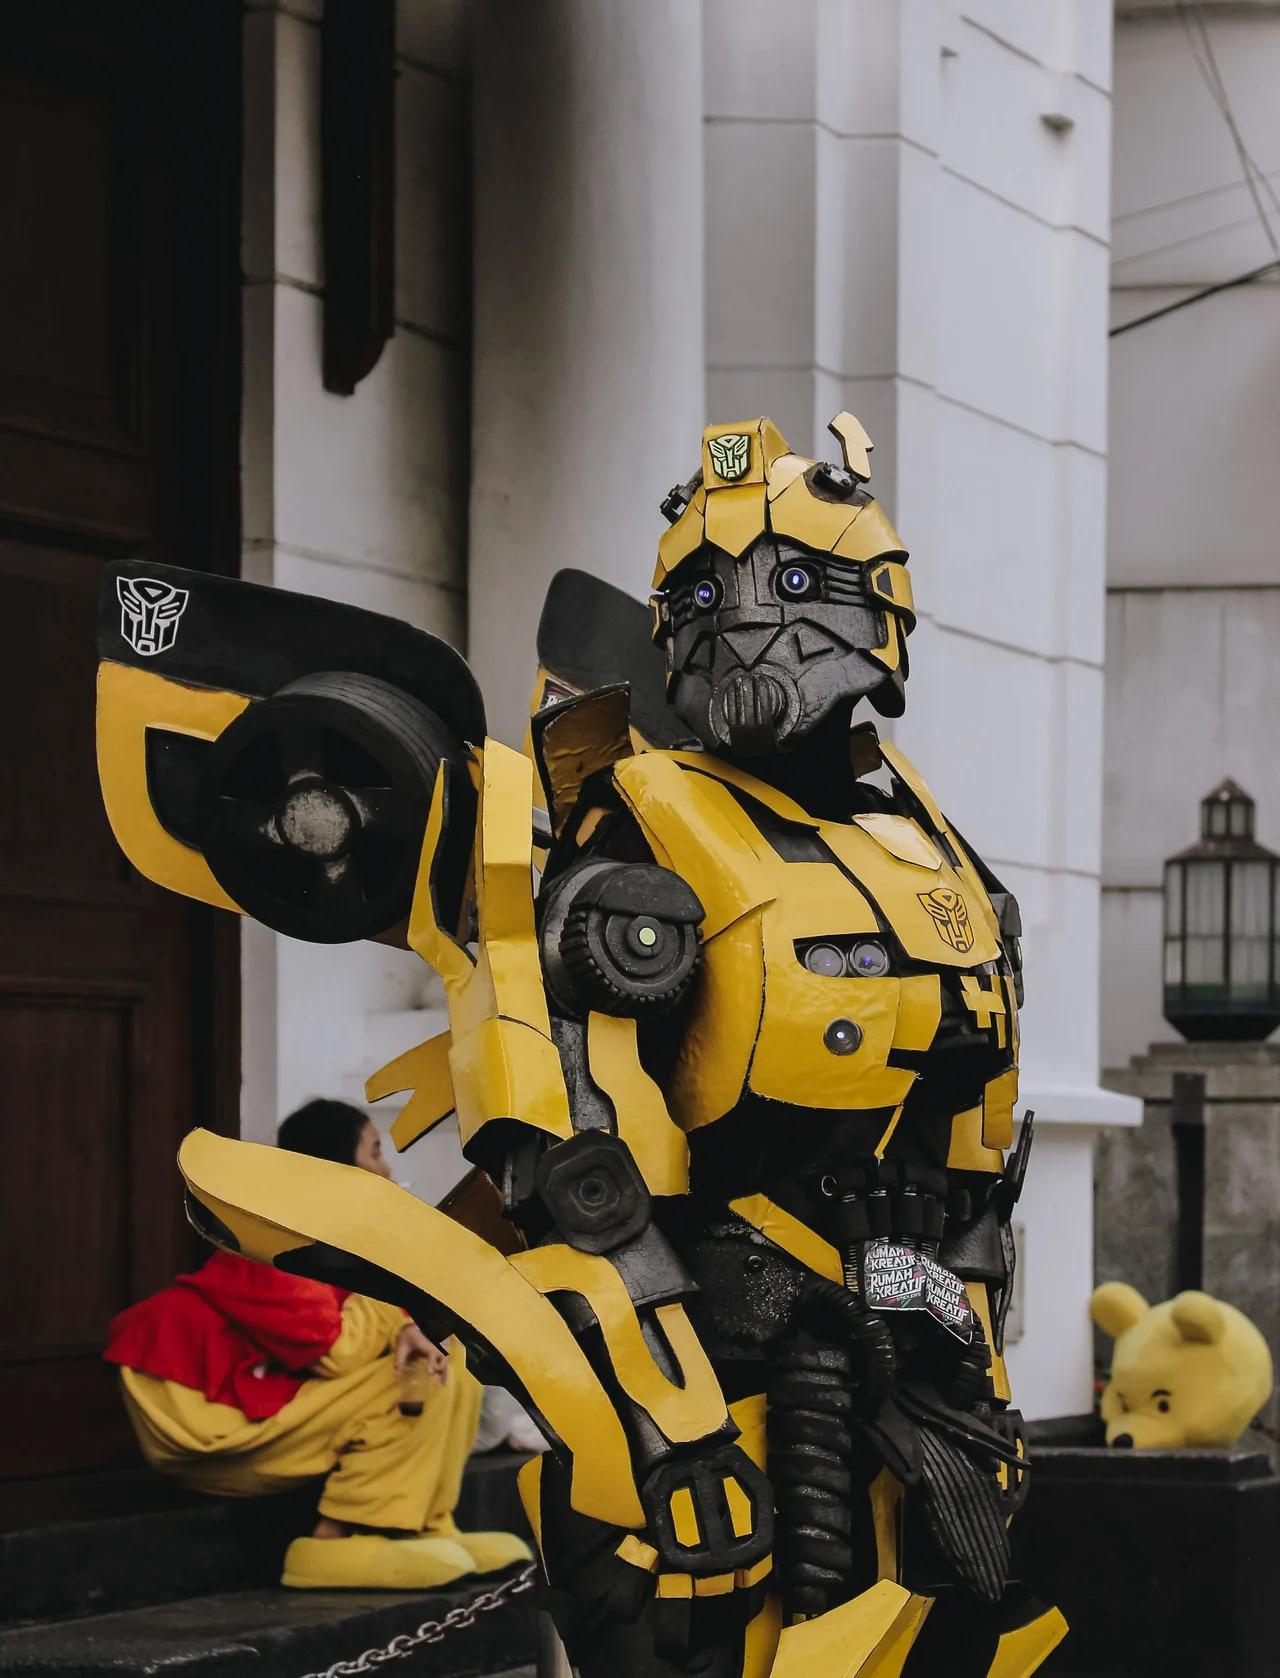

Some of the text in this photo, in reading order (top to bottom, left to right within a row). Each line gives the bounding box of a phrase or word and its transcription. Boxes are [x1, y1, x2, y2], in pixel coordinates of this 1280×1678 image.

[871, 1254, 917, 1271] KREATIF
[870, 1268, 913, 1294] RUMAH
[876, 1276, 927, 1301] KREATIF
[926, 1268, 965, 1294] KREATIF
[926, 1278, 960, 1305] RUMAH
[926, 1292, 970, 1321] KREATIF
